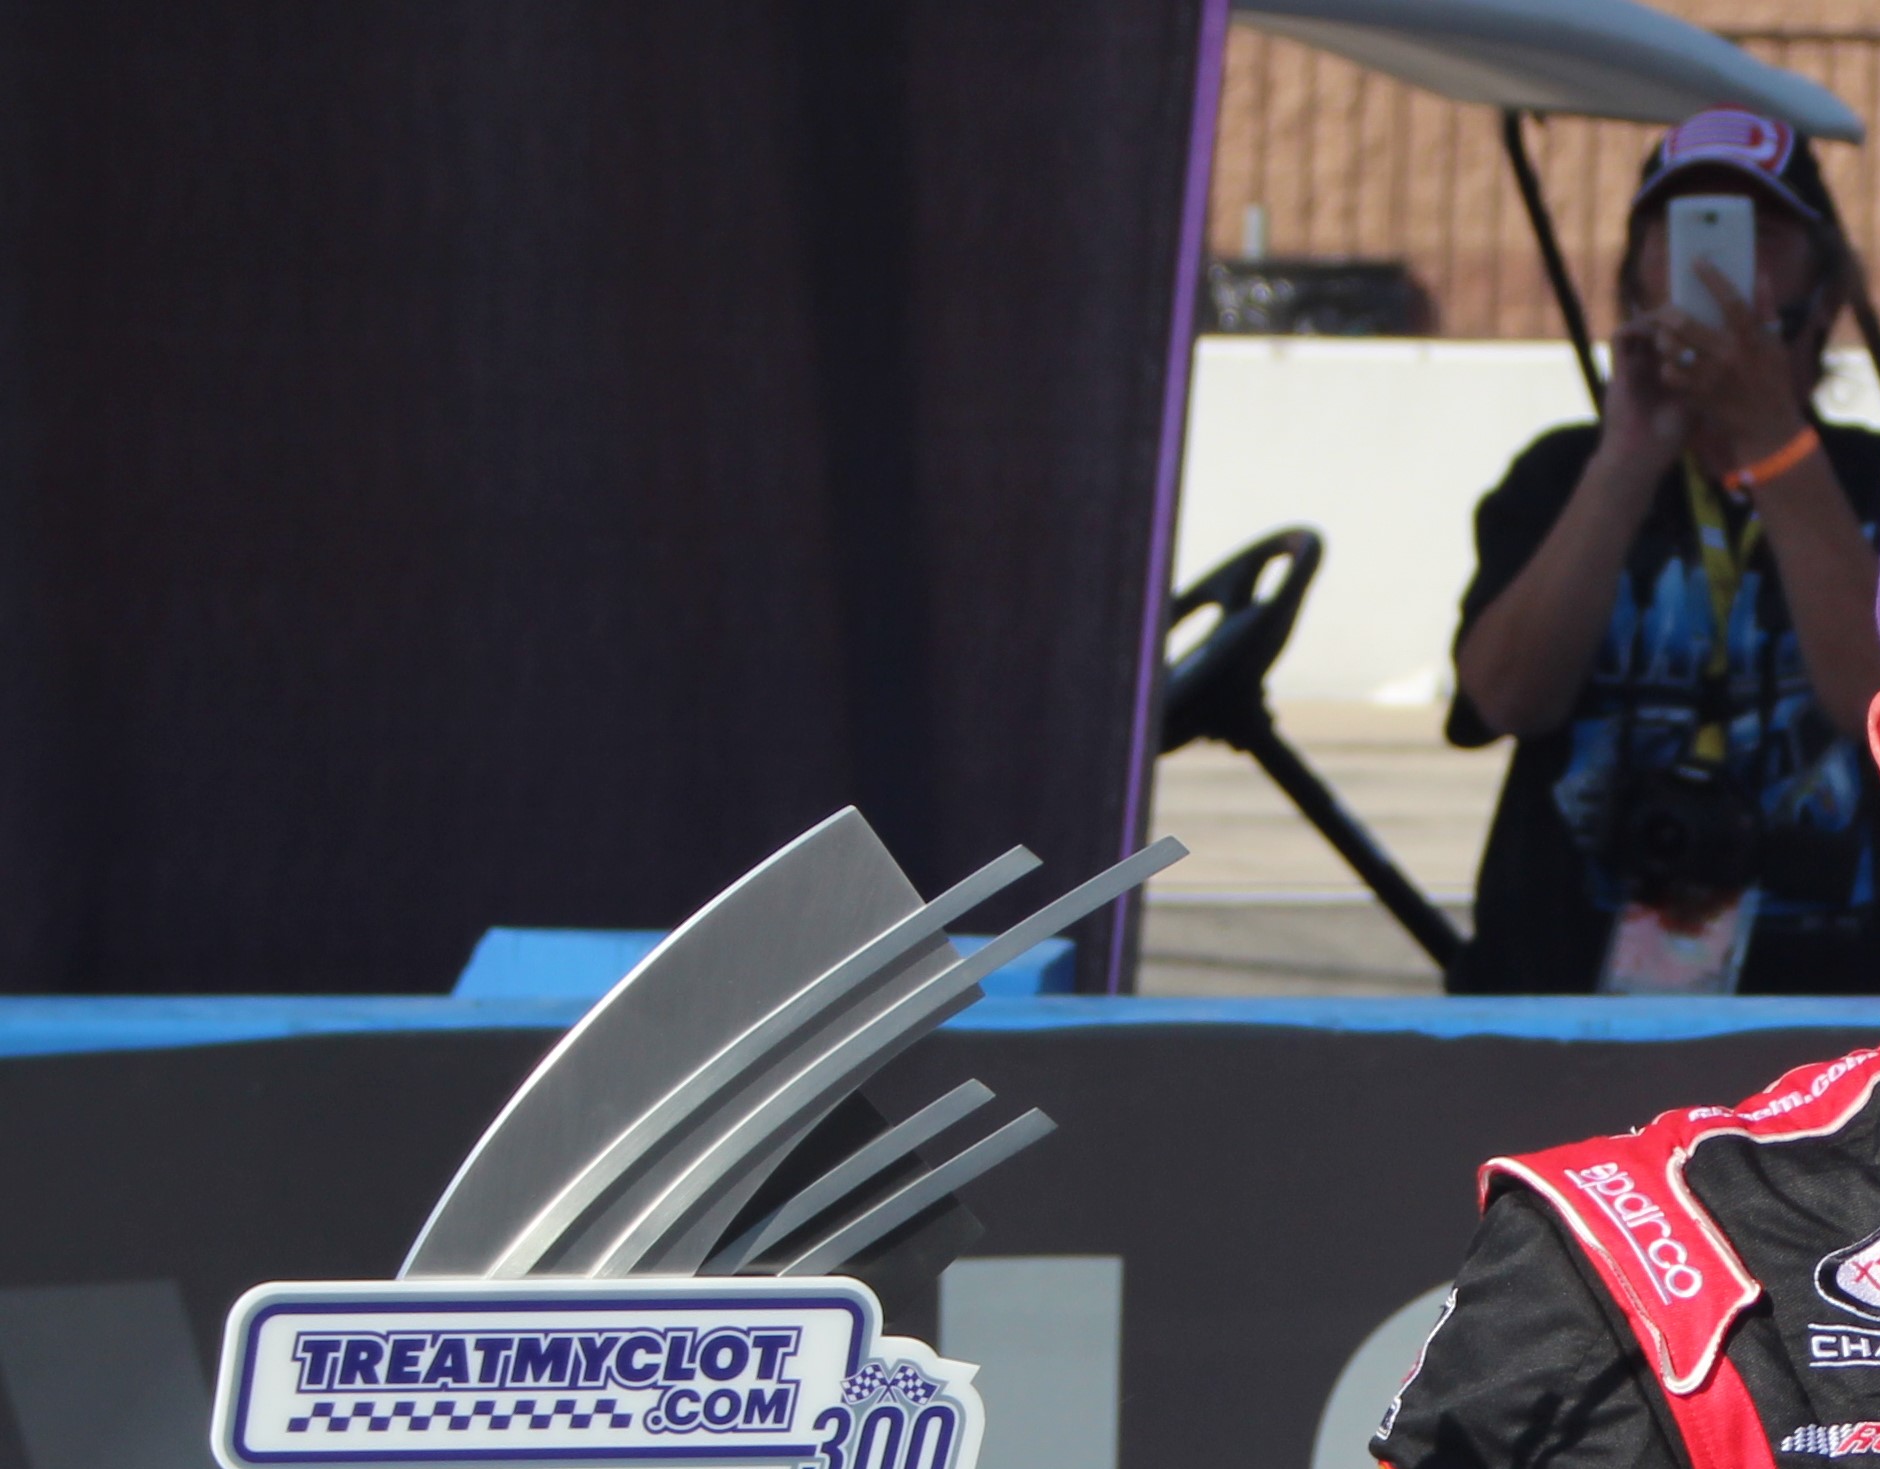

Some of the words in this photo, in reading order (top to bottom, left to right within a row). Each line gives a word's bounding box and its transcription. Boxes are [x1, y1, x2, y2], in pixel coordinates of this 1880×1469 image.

[1569, 1162, 1703, 1303] sparco
[297, 1331, 798, 1390] TREATMYCLOT
[647, 1387, 794, 1432] .COM
